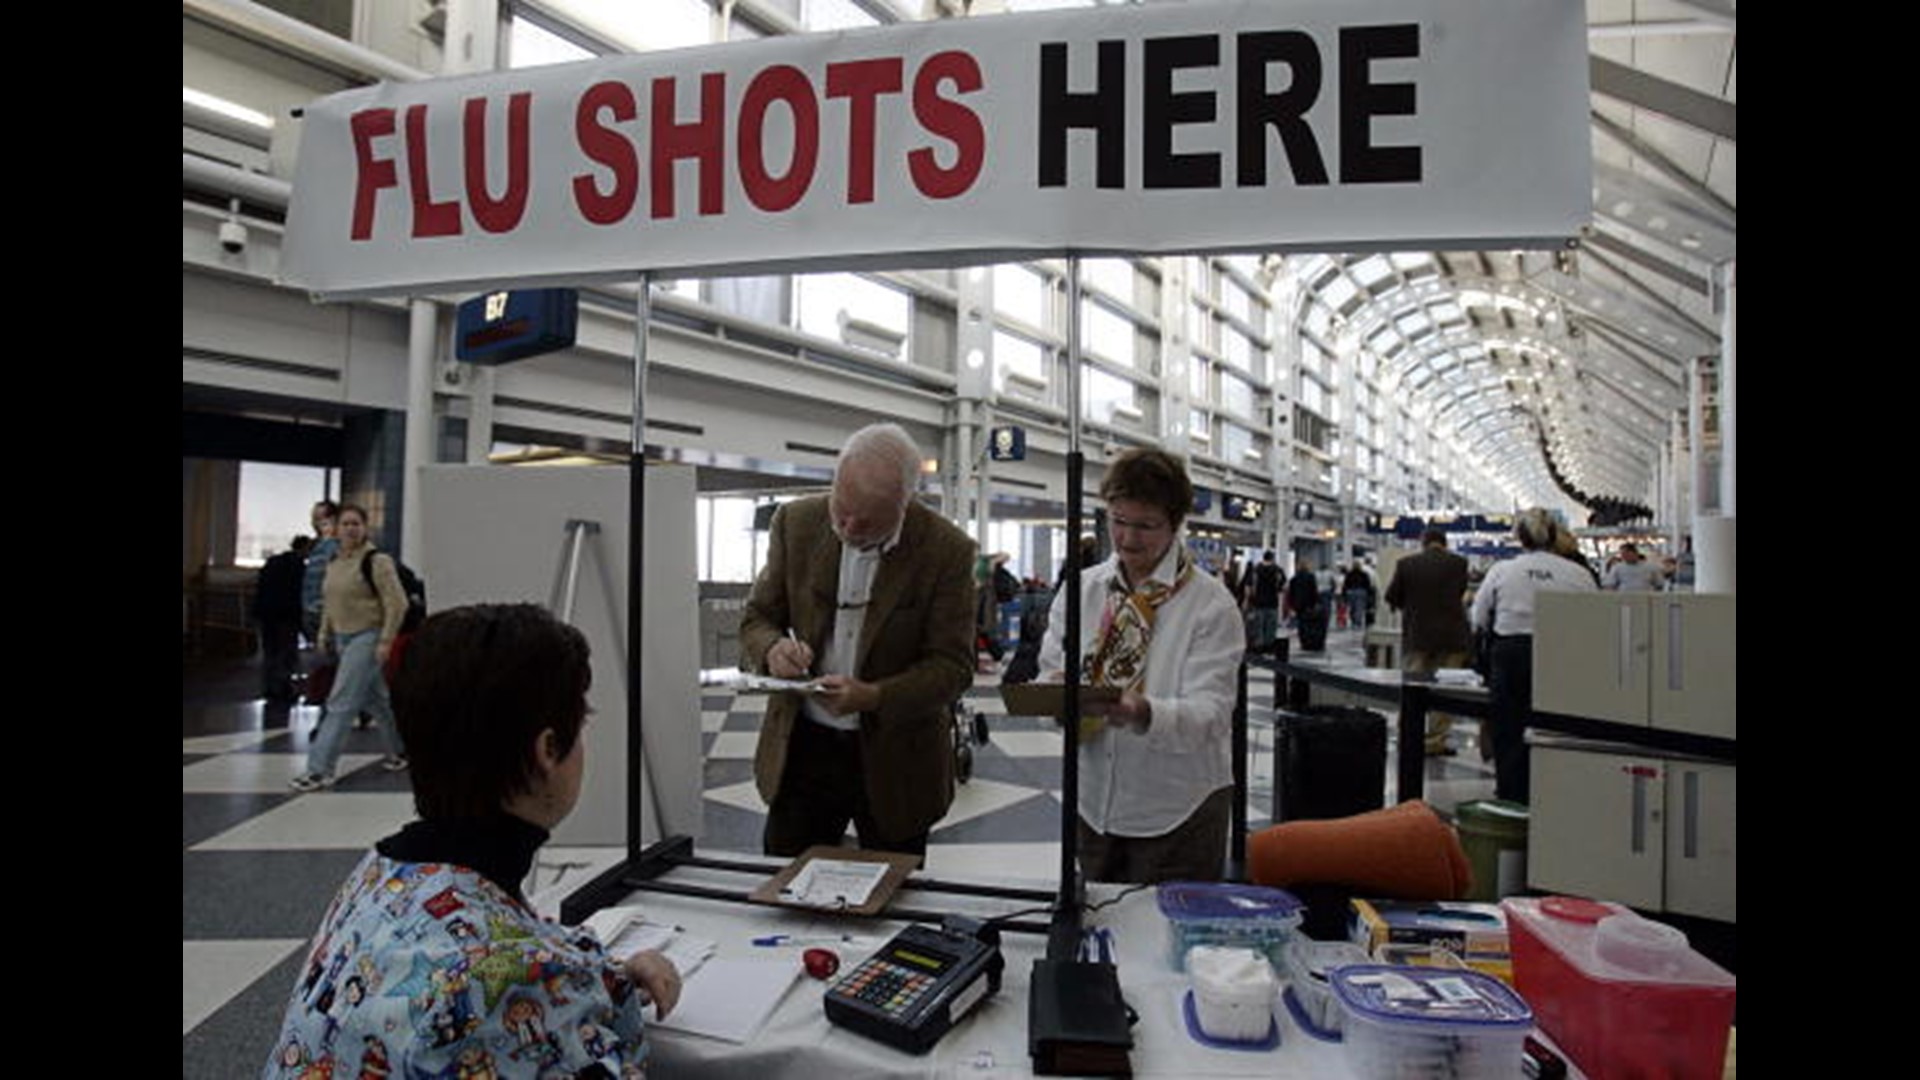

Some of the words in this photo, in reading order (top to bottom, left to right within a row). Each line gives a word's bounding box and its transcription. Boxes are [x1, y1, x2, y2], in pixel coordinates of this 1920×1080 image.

[350, 93, 532, 240] FLU
[573, 50, 986, 226] SHOTS
[1037, 23, 1423, 189] HERE
